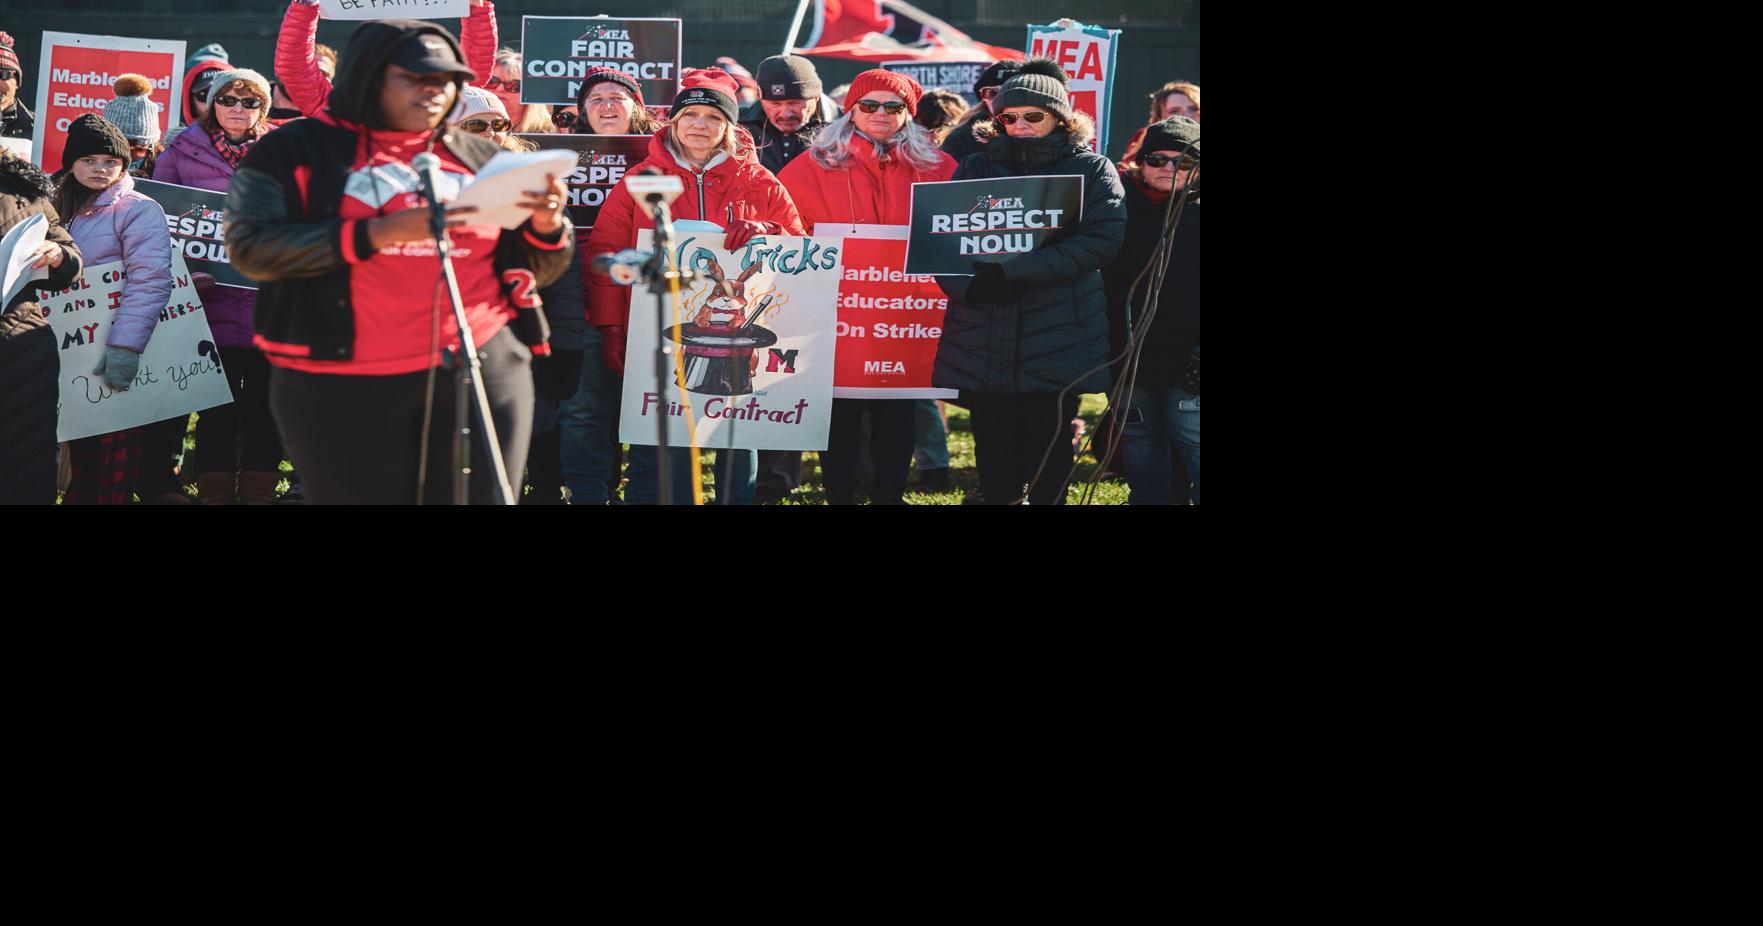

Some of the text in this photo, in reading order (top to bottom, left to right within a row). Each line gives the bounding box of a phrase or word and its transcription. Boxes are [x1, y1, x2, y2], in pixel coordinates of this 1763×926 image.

[598, 30, 630, 40] MEA
[571, 40, 635, 58] FAIR
[940, 65, 981, 84] SHORE
[56, 118, 70, 133] O
[592, 153, 628, 165] MEA
[564, 188, 613, 206] NO
[990, 197, 1024, 209] MEA
[932, 209, 1063, 233] RESPECT
[960, 233, 1034, 255] NOW
[731, 236, 839, 275] Tricks
[504, 268, 538, 308] 2
[63, 298, 96, 313] AND
[61, 322, 99, 350] MY
[873, 322, 942, 339] Strike
[765, 348, 798, 374] M
[864, 360, 906, 373] MEA
[704, 396, 809, 425] Contract
